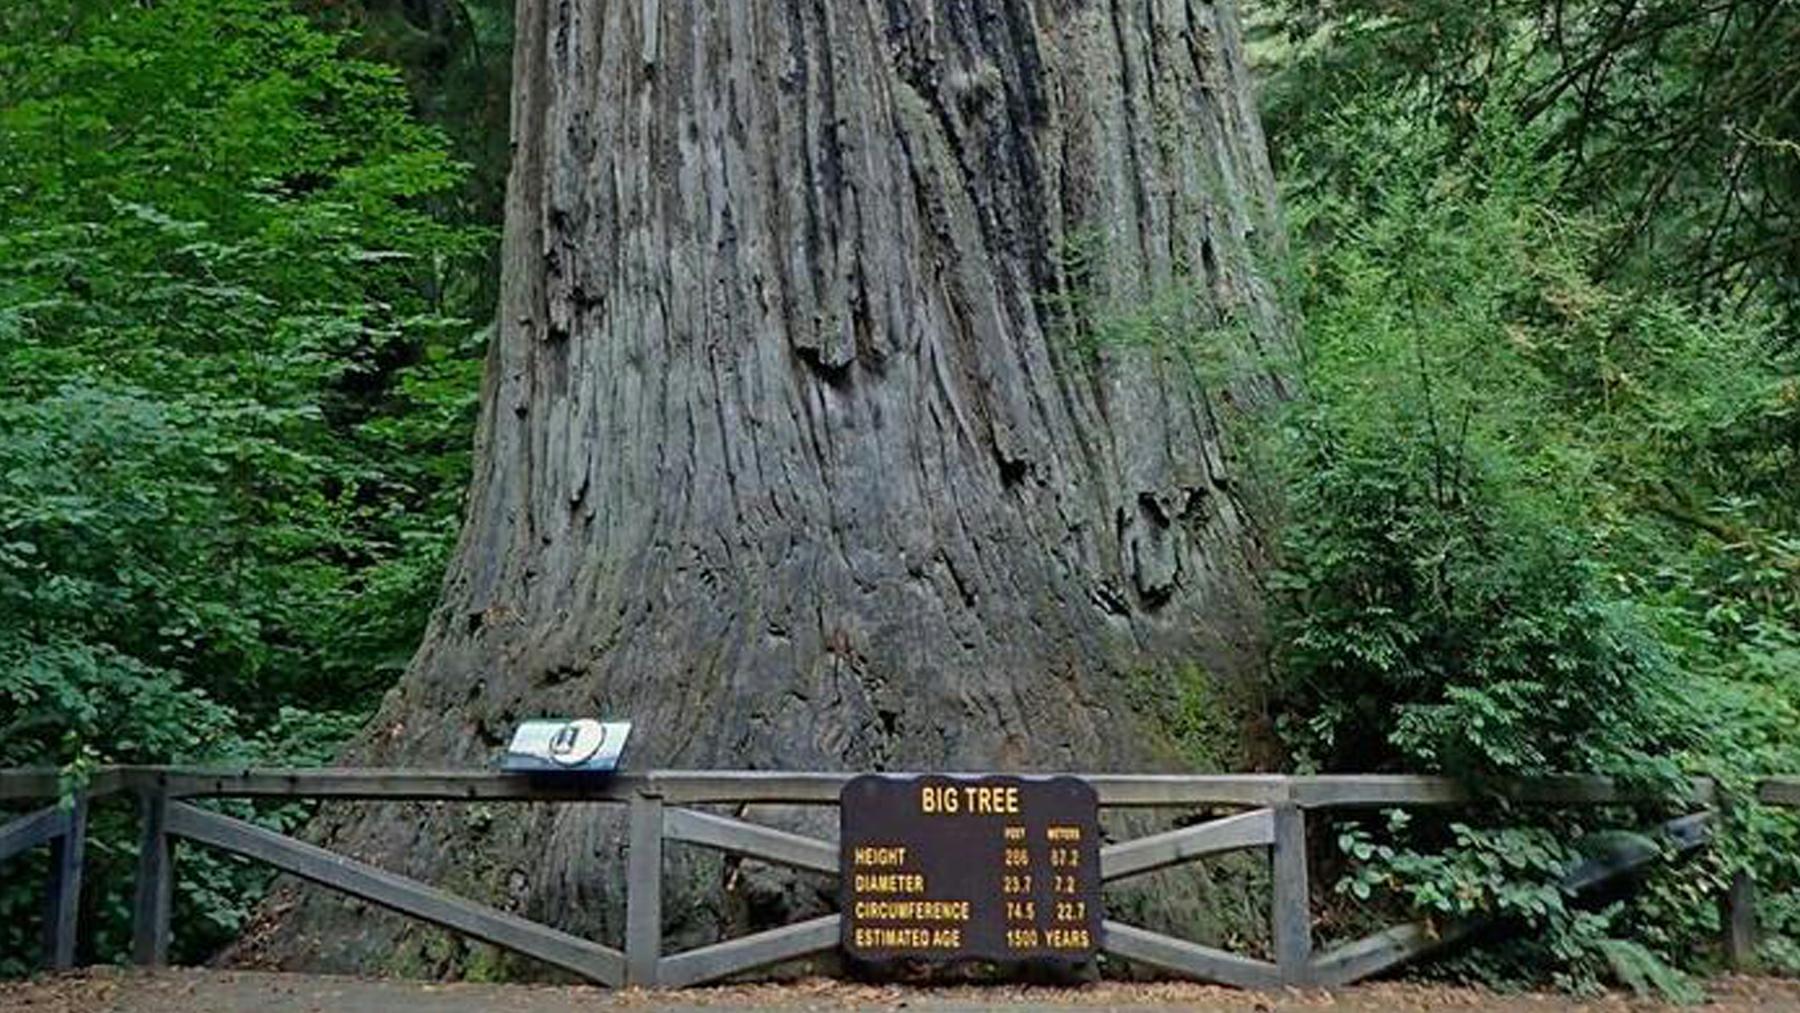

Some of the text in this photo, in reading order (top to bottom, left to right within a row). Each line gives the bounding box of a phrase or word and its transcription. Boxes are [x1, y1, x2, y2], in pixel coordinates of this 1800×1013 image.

[922, 787, 1019, 813] BIG TREE
[854, 848, 905, 865] HEIGHT
[855, 874, 1075, 893] DIAMETER 23.7 7.2
[855, 901, 1086, 921] CIRCUMFERENCE 74.5 22.7
[855, 928, 1090, 948] ESTIMATED AGE 1500 YEARS
